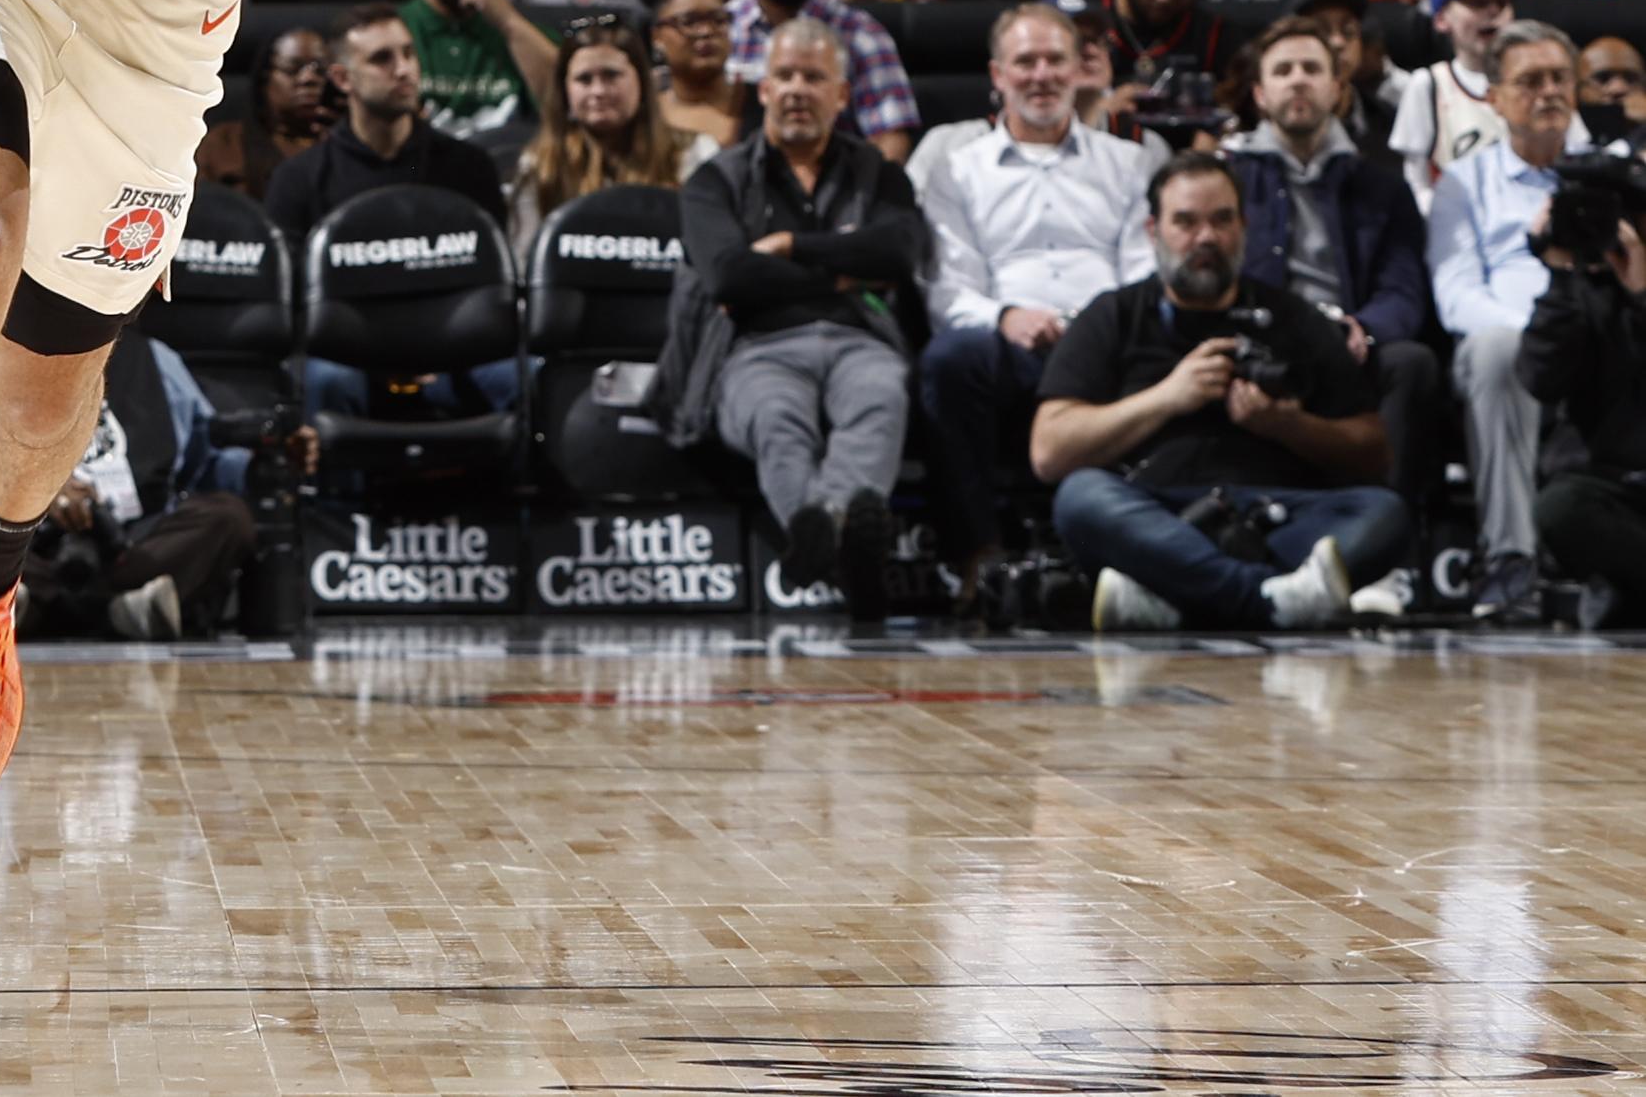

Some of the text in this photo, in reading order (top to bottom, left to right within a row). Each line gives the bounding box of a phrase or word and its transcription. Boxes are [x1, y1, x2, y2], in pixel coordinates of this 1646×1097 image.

[110, 187, 187, 220] PISTONS
[329, 230, 479, 268] FIEGERLAW
[558, 233, 685, 261] FIEGERLA
[351, 512, 489, 562] Little
[575, 512, 713, 564] Little
[310, 549, 510, 602] Caesars
[536, 555, 737, 606] Caesars
